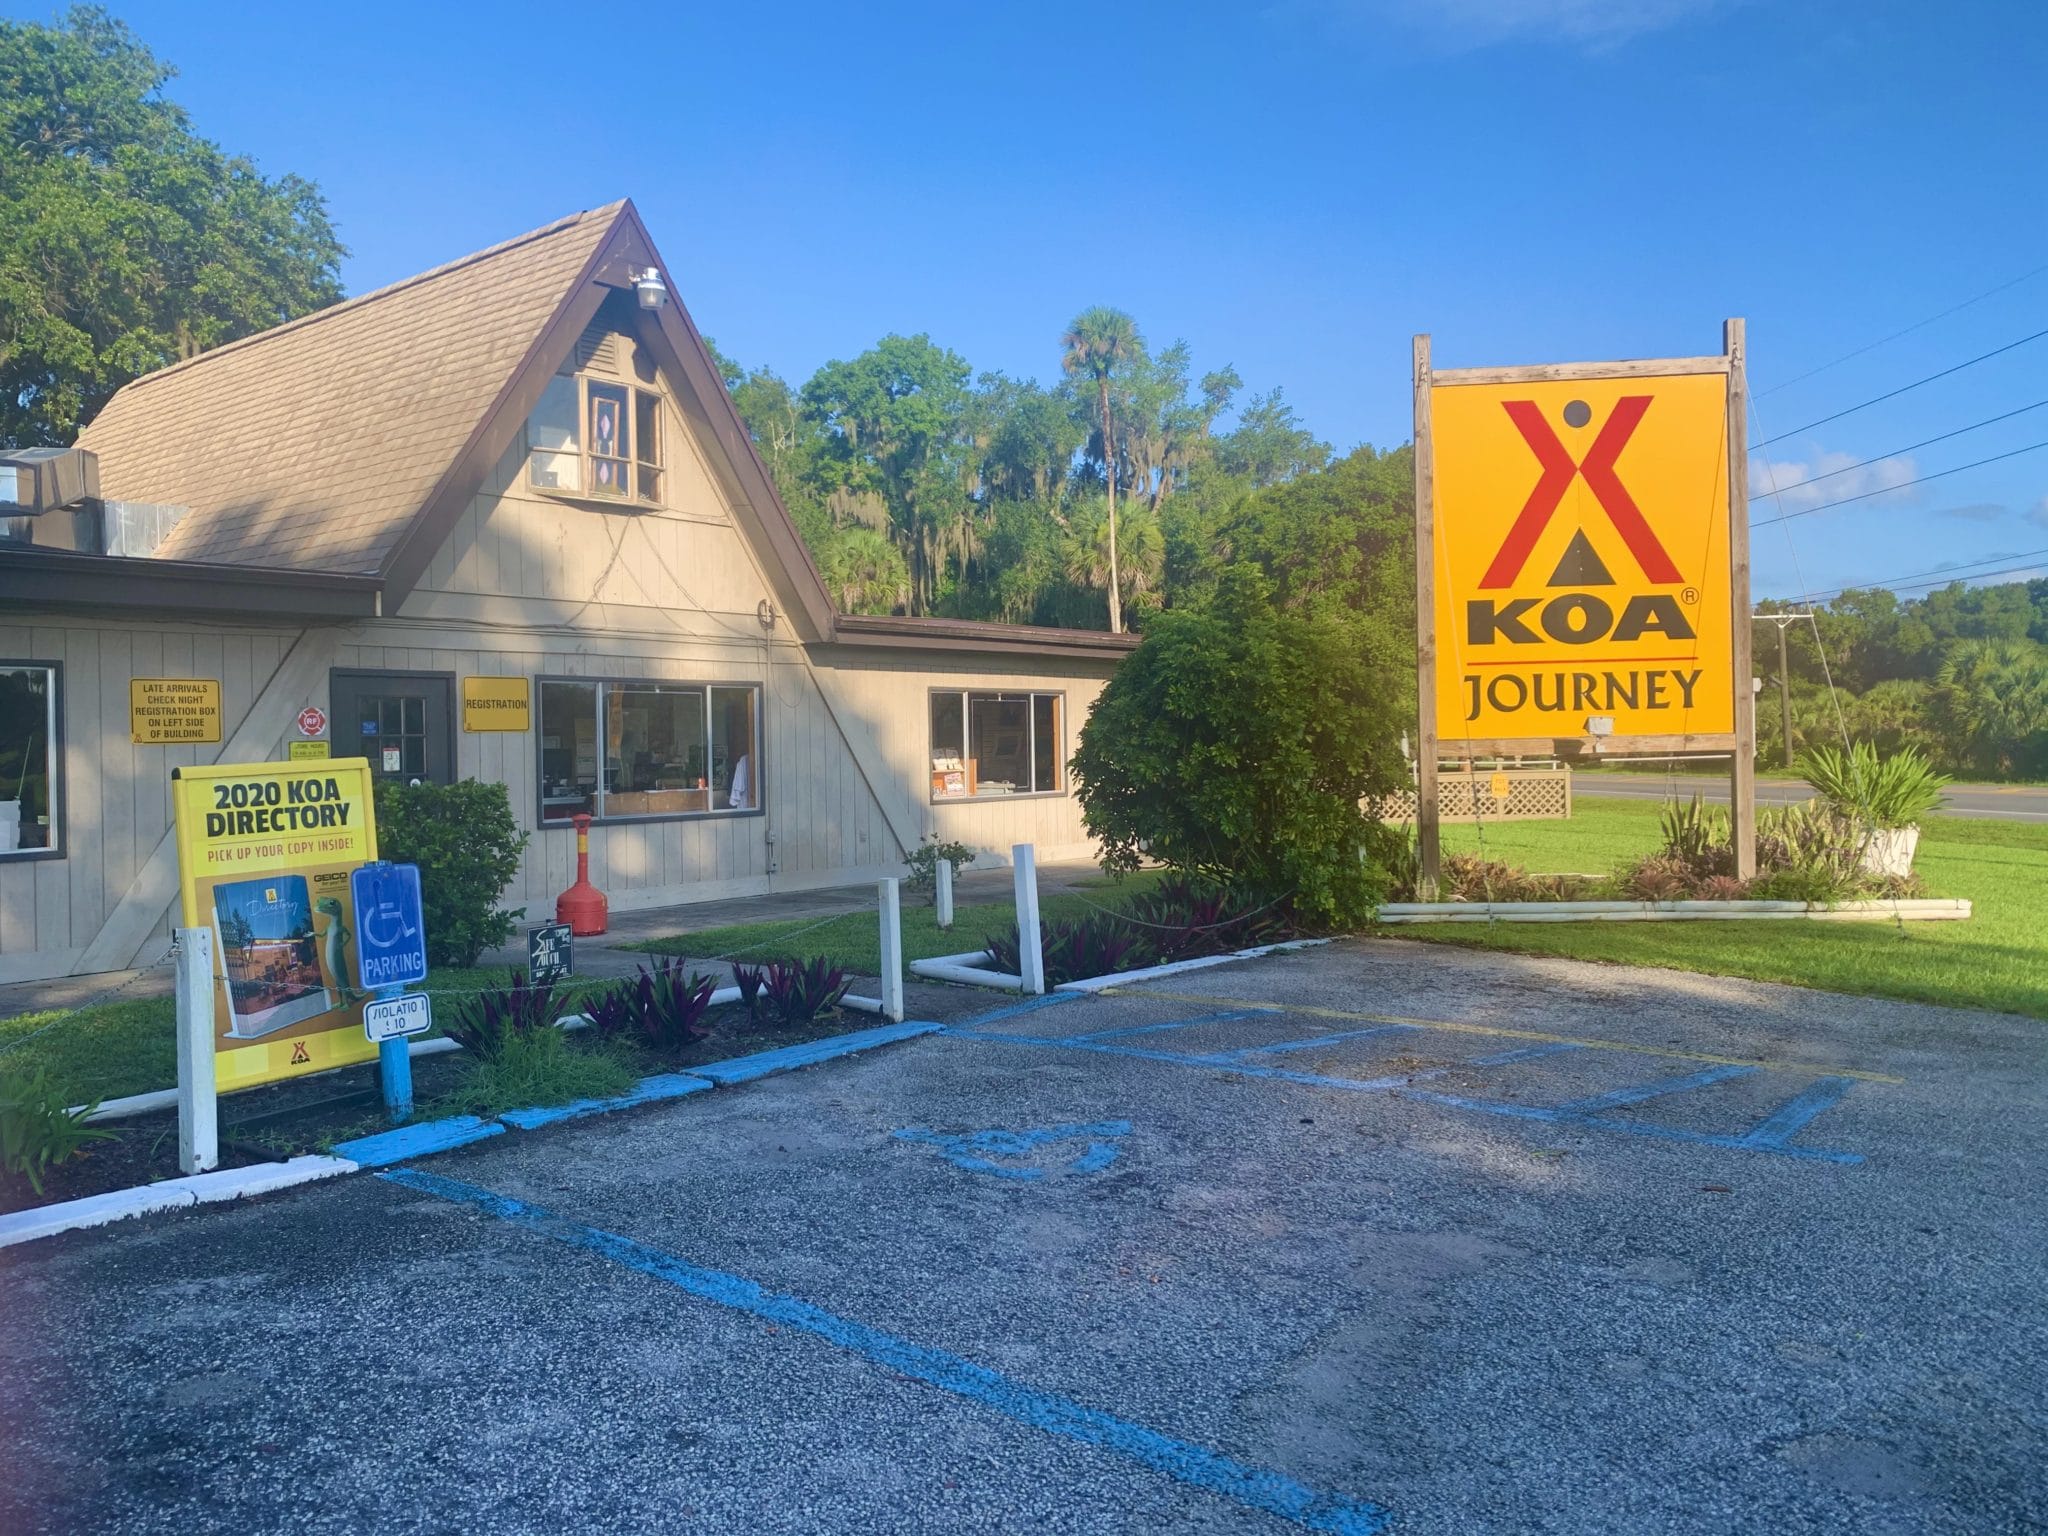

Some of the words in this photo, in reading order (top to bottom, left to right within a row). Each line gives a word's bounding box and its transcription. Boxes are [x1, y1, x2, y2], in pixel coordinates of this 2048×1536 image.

[1467, 592, 1697, 645] KOA
[143, 684, 164, 693] LATE
[166, 684, 208, 693] ARRIVALS
[147, 695, 176, 705] CHECK
[178, 695, 204, 705] NIGHT
[1464, 669, 1704, 721] JOURNEY
[465, 699, 527, 709] REGISTRATION
[135, 707, 197, 716] REGISTRATION
[199, 707, 216, 716] BOX
[148, 718, 161, 727] ON
[163, 718, 183, 727] LEFT
[185, 718, 205, 727] SIDE
[306, 717, 318, 725] RF
[150, 729, 162, 739] OF
[164, 729, 204, 738] BUILDING
[213, 781, 282, 810] 2020
[287, 778, 341, 804] KOA
[206, 802, 350, 838] DIRECTORY
[207, 849, 233, 862] PICK
[237, 847, 251, 860] UP
[254, 844, 284, 858] YOUR
[287, 841, 314, 855] COPY
[318, 837, 354, 852] INSIDE!
[313, 872, 348, 882] GEICO
[246, 899, 299, 917] Directory
[365, 951, 422, 978] PARKING
[291, 1057, 311, 1065] KOA
